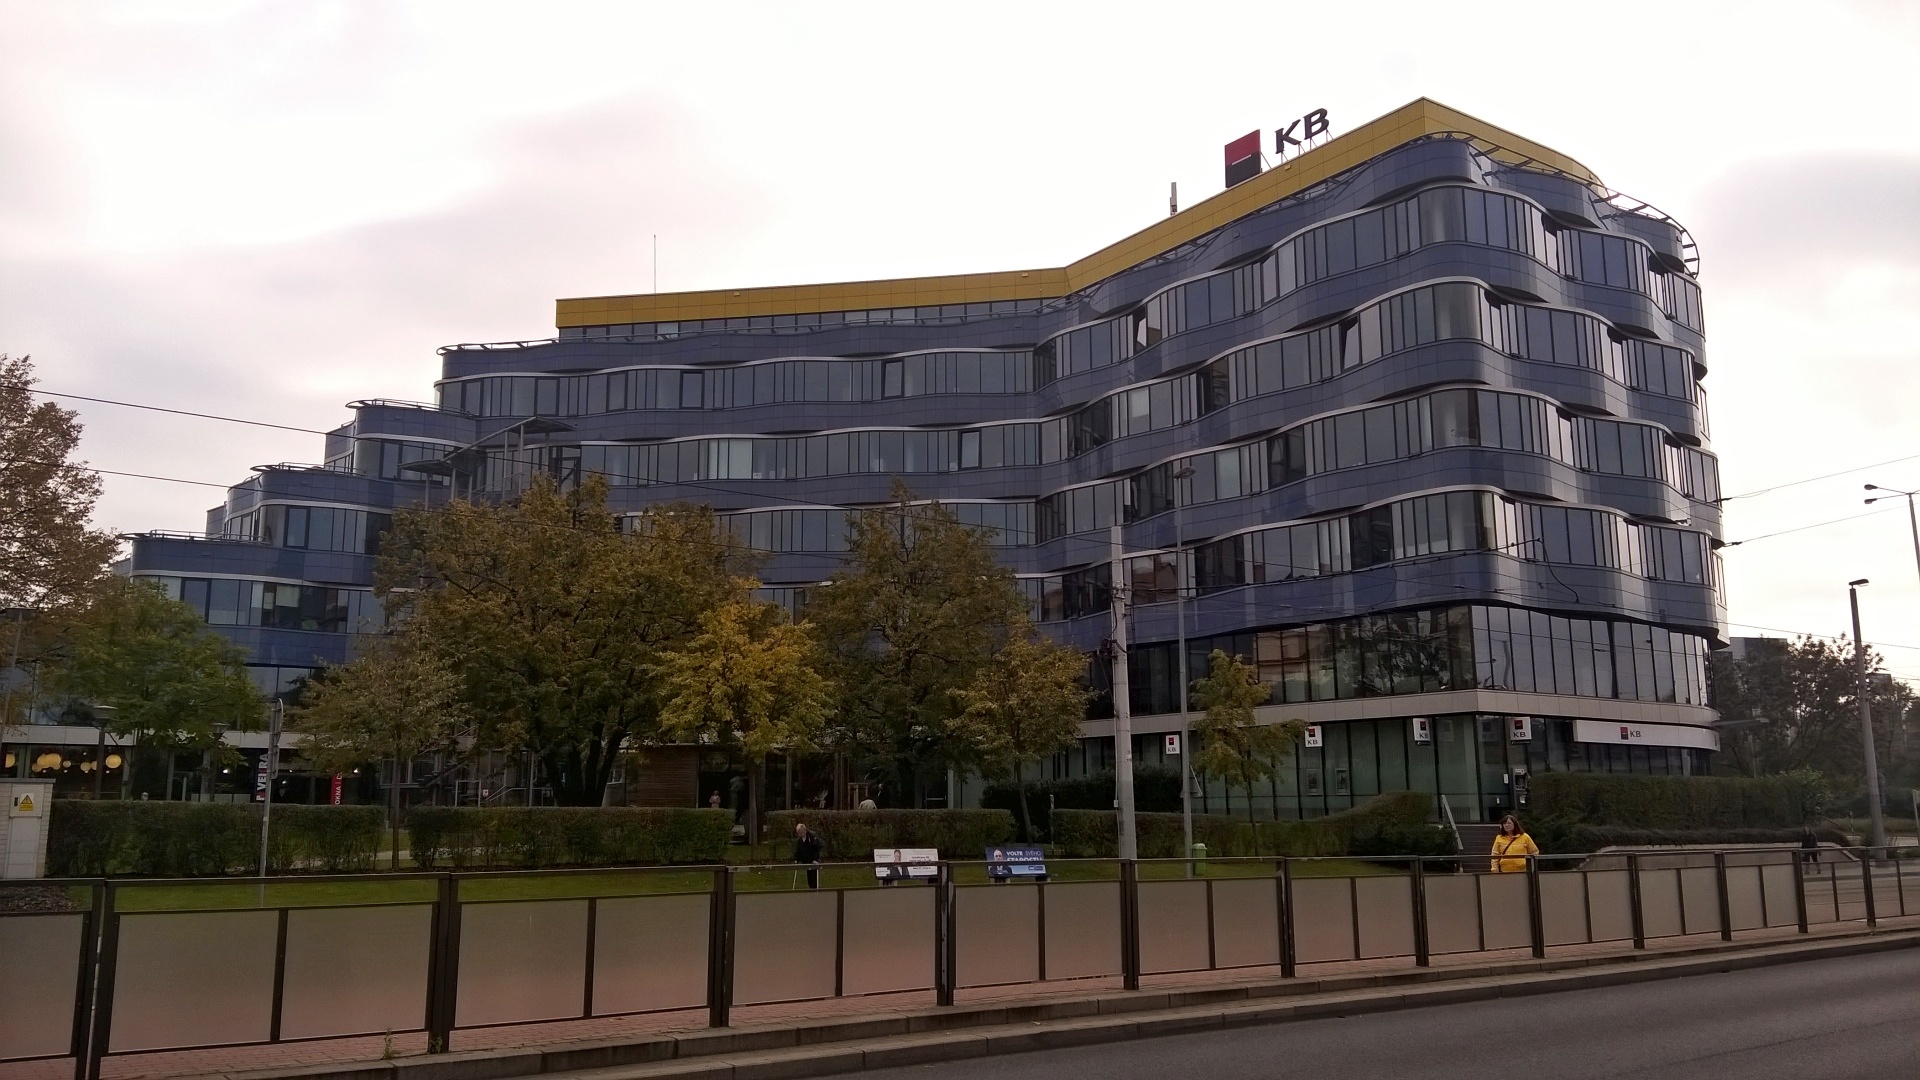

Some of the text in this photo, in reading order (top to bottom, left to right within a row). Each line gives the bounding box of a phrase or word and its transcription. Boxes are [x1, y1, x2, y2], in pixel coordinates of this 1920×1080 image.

[1274, 107, 1329, 154] KB
[1629, 730, 1641, 738] KB
[334, 786, 342, 805] OKNA
